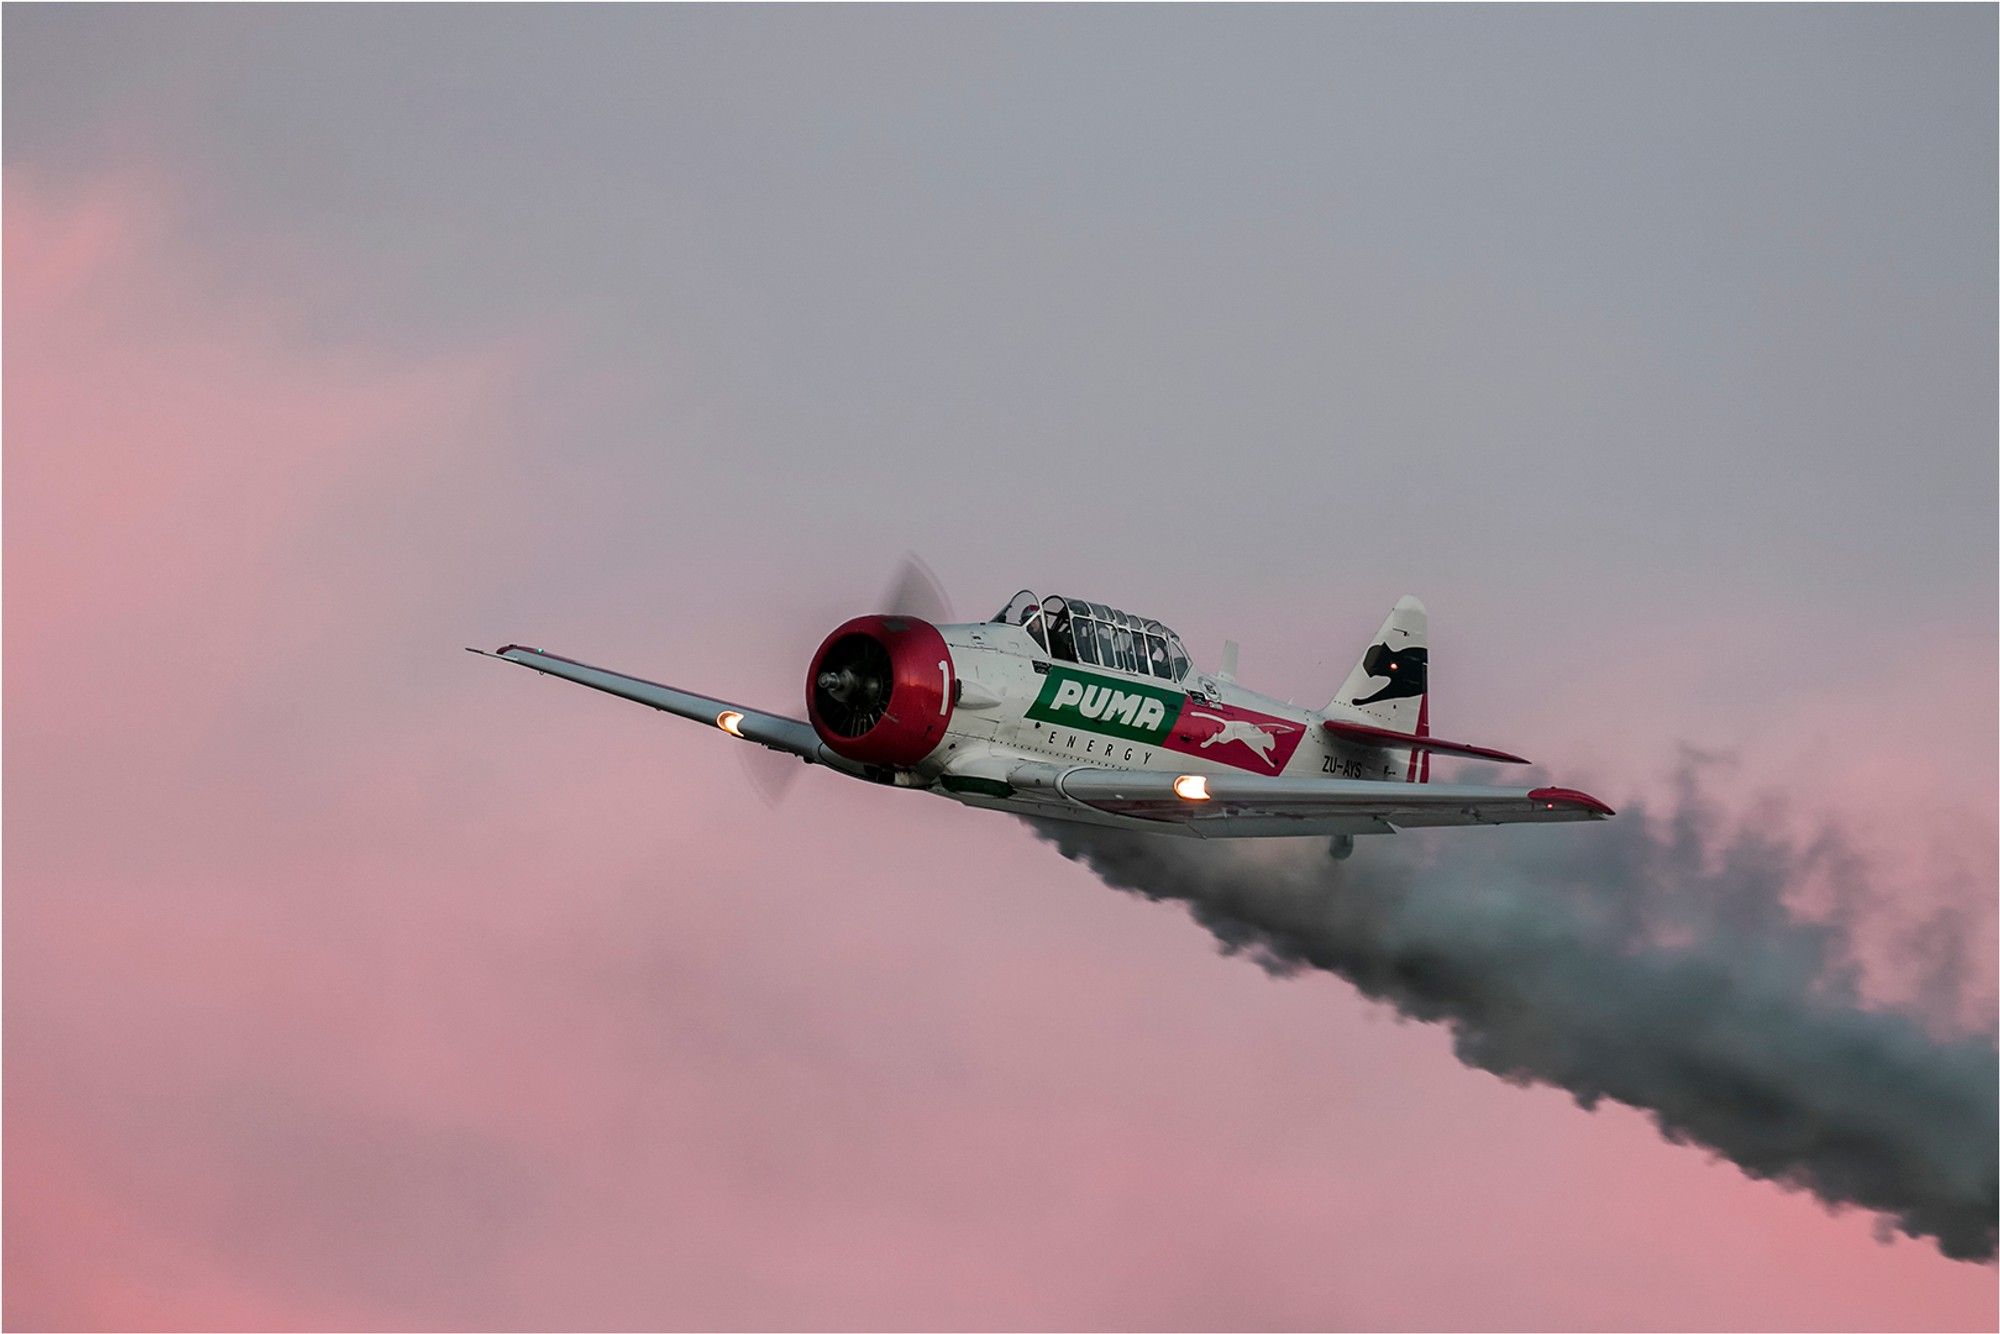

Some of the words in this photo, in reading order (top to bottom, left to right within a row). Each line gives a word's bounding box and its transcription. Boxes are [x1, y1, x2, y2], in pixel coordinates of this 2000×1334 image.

[938, 660, 950, 716] 1
[1049, 679, 1165, 731] PUMA
[1048, 731, 1152, 765] ENERGY
[1322, 755, 1362, 779] ZU-AYS
